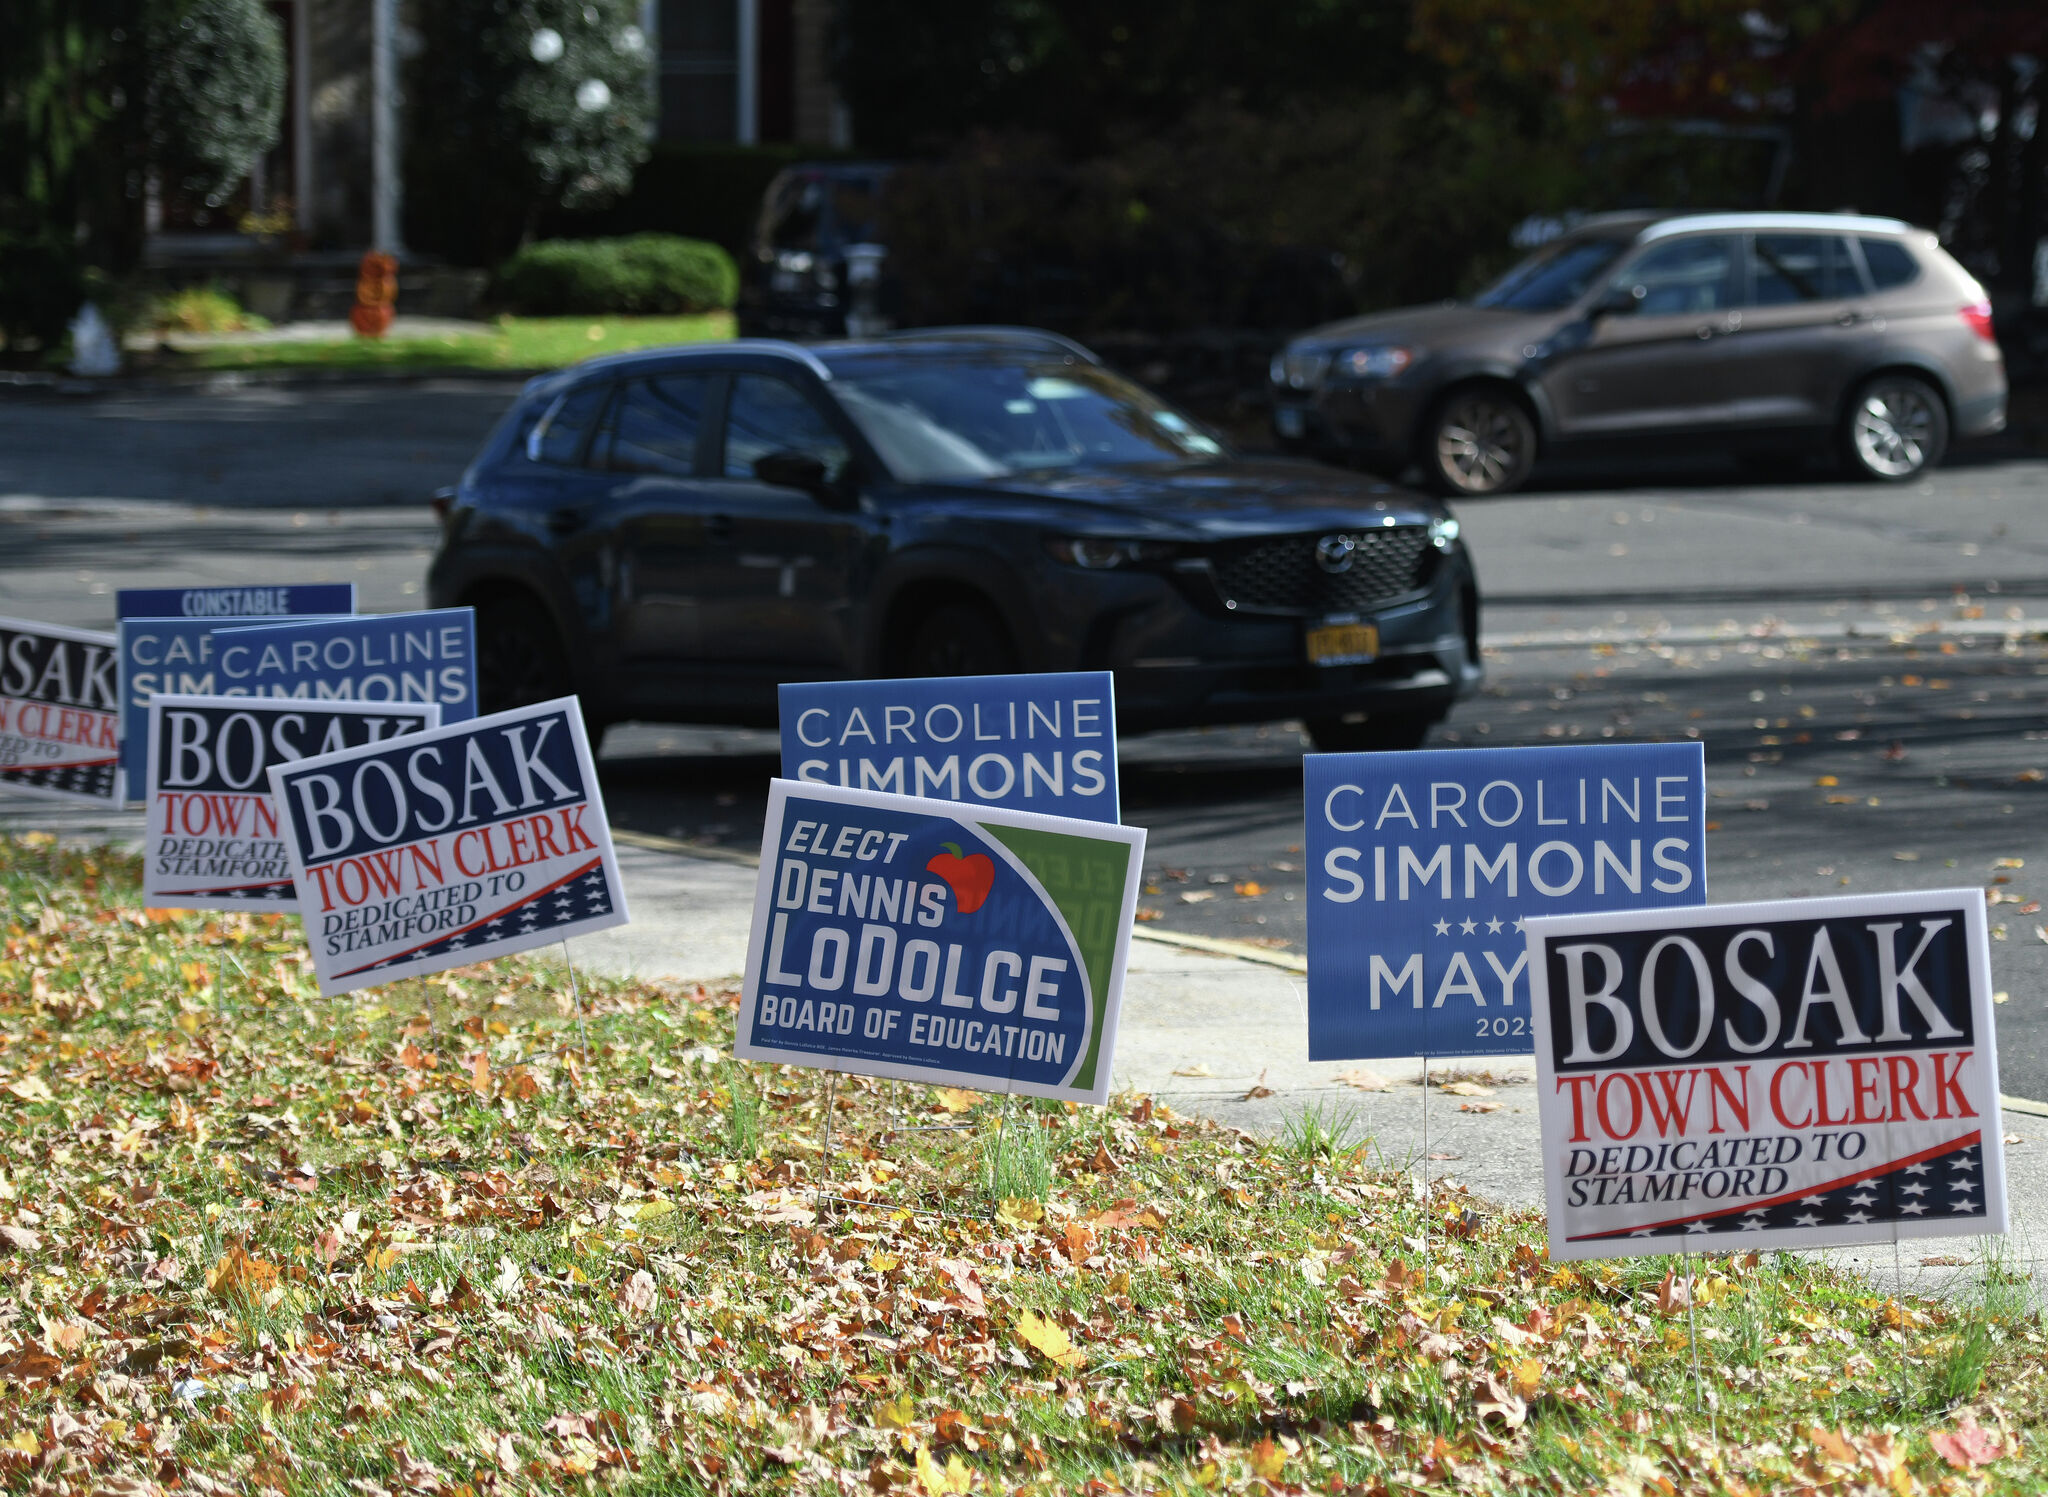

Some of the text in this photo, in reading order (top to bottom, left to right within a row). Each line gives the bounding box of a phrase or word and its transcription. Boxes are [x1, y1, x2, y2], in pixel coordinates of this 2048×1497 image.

[182, 587, 289, 616] CONSTABLE
[0, 633, 118, 712] SAK
[221, 626, 465, 679] CAROLINE
[17, 703, 119, 751] CLERK
[33, 741, 63, 759] TO
[163, 711, 418, 790] BOS
[796, 699, 1103, 748] CAROLINE
[157, 792, 278, 839] TOWN
[290, 717, 579, 860] BOSAK
[1324, 776, 1689, 832] CAROLINE
[156, 838, 290, 861] DEDICATE
[306, 804, 598, 913] TOWN CLERK
[785, 820, 909, 864] ELECT
[1323, 837, 1693, 903] SIMMONS
[322, 871, 526, 937] DEDICATED TO
[776, 858, 947, 928] DENNIS
[326, 904, 476, 956] STAMFORD
[1369, 950, 1529, 1010] MAY
[1555, 918, 1965, 1064] BOSAK
[759, 995, 855, 1036] BOARD
[863, 1007, 902, 1041] OF
[909, 1014, 1066, 1065] EDUCATION
[1555, 1051, 1980, 1144] TOWN CLERK
[1564, 1131, 1867, 1179] DEDICATED TO
[1567, 1166, 1789, 1208] STAMFORD
